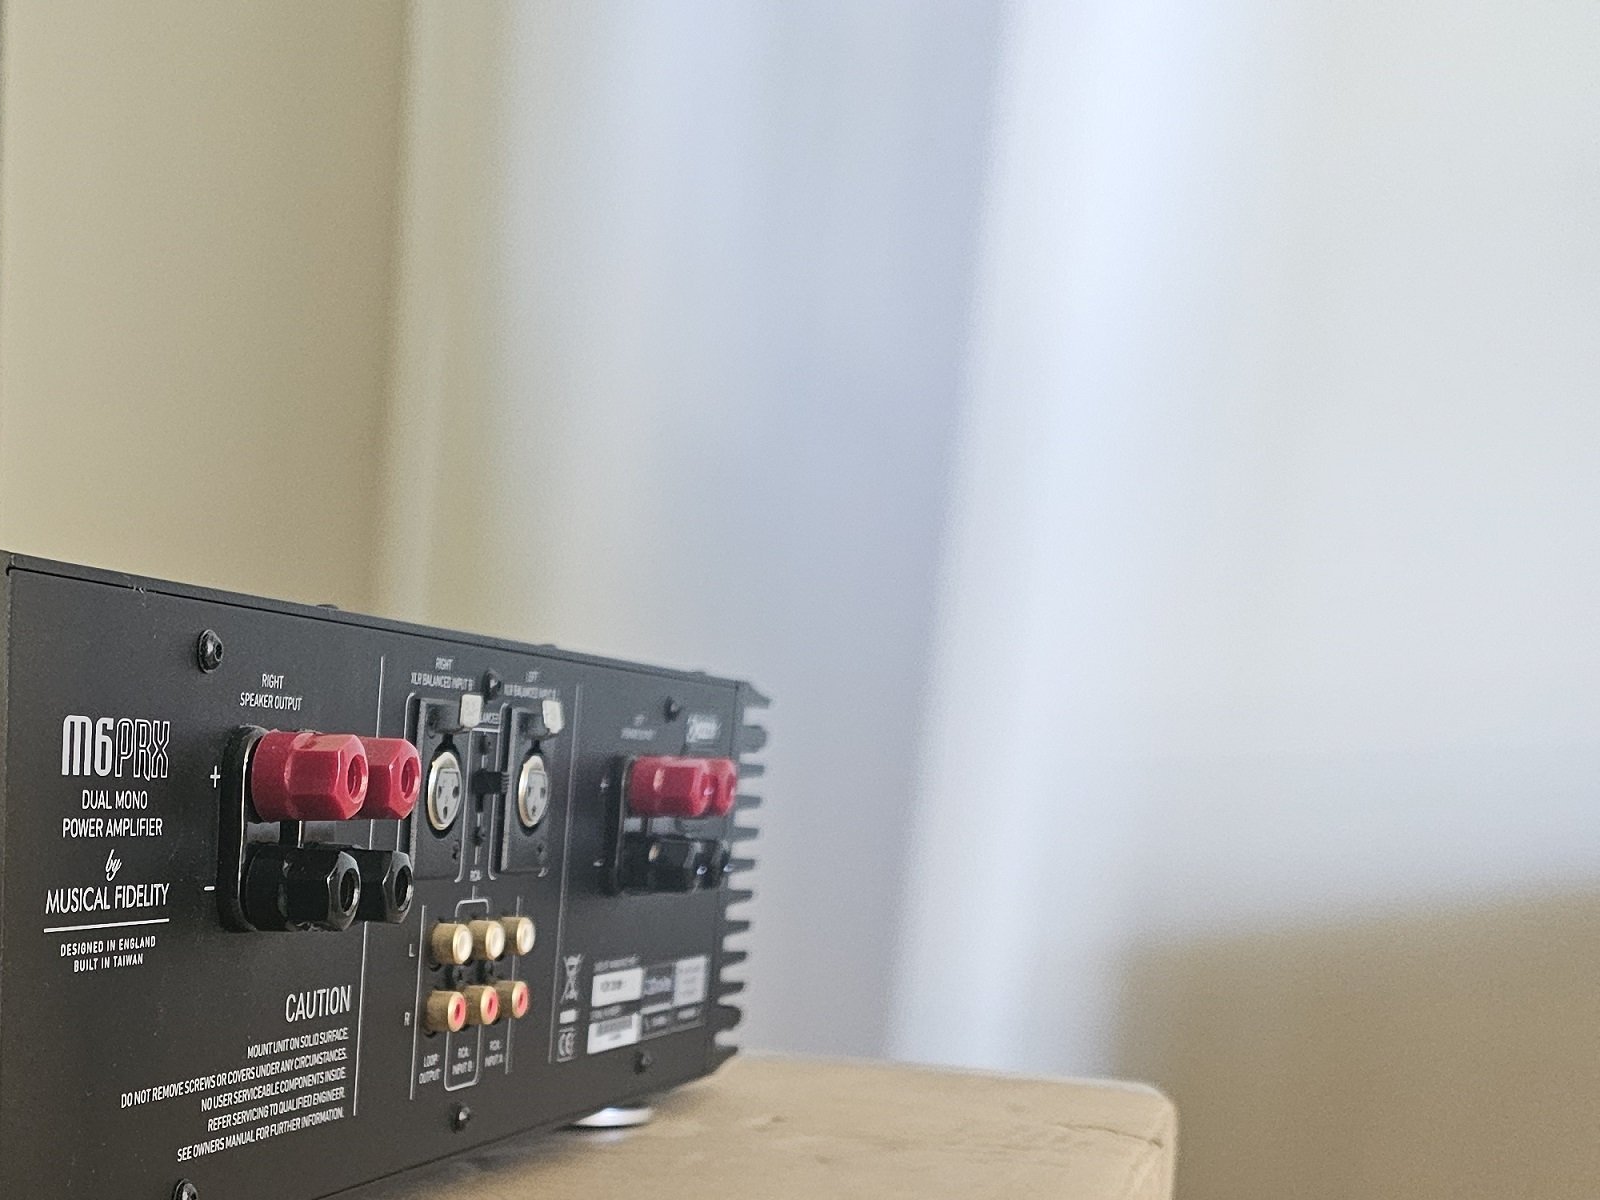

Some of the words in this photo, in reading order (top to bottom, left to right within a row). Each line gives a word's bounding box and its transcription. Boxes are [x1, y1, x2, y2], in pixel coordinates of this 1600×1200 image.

[262, 673, 284, 689] RIGHT
[240, 692, 273, 708] SPEAKER
[274, 695, 303, 711] OUTPUT
[62, 715, 170, 781] M6PRX
[82, 790, 112, 809] DUAL
[115, 790, 148, 809] MONO
[62, 818, 103, 838] POWER
[105, 817, 163, 837] AMPLIFIER
[105, 849, 122, 881] by
[45, 886, 111, 914] MUSICAL
[114, 883, 170, 909] FIDELITY
[60, 940, 104, 957] DESIGNED
[106, 939, 116, 952] IN
[118, 935, 156, 951] ENGLAND
[73, 957, 99, 973] BUILT
[101, 956, 110, 969] IN
[112, 953, 144, 968] TAIWAN
[285, 984, 351, 1023] CAUTION
[247, 1041, 273, 1059] MOUNT
[273, 1038, 290, 1053] UNIT
[289, 1036, 300, 1050] ON
[300, 1032, 319, 1049] SOLID
[121, 1092, 133, 1109] DO
[134, 1088, 151, 1106] NOT
[152, 1081, 184, 1102] REMOVE
[184, 1074, 216, 1095] SCREWS
[216, 1072, 227, 1087] OR
[228, 1066, 255, 1085] COVERS
[255, 1061, 280, 1079] UNDER
[280, 1058, 294, 1073] ANY
[201, 1097, 213, 1112] NO
[213, 1092, 233, 1109] USER
[233, 1081, 280, 1105] SERVICEABLE
[280, 1071, 324, 1094] COMPONENTS
[207, 1113, 232, 1132] REFER
[232, 1104, 269, 1126] SERVICING
[269, 1102, 279, 1117] TO
[278, 1094, 313, 1114] QUALIFIED
[177, 1145, 193, 1162] SEE
[193, 1137, 225, 1157] OWNERS
[225, 1129, 255, 1149] MANUAL
[255, 1125, 270, 1141] FOR
[270, 1116, 301, 1136] FURTHER
